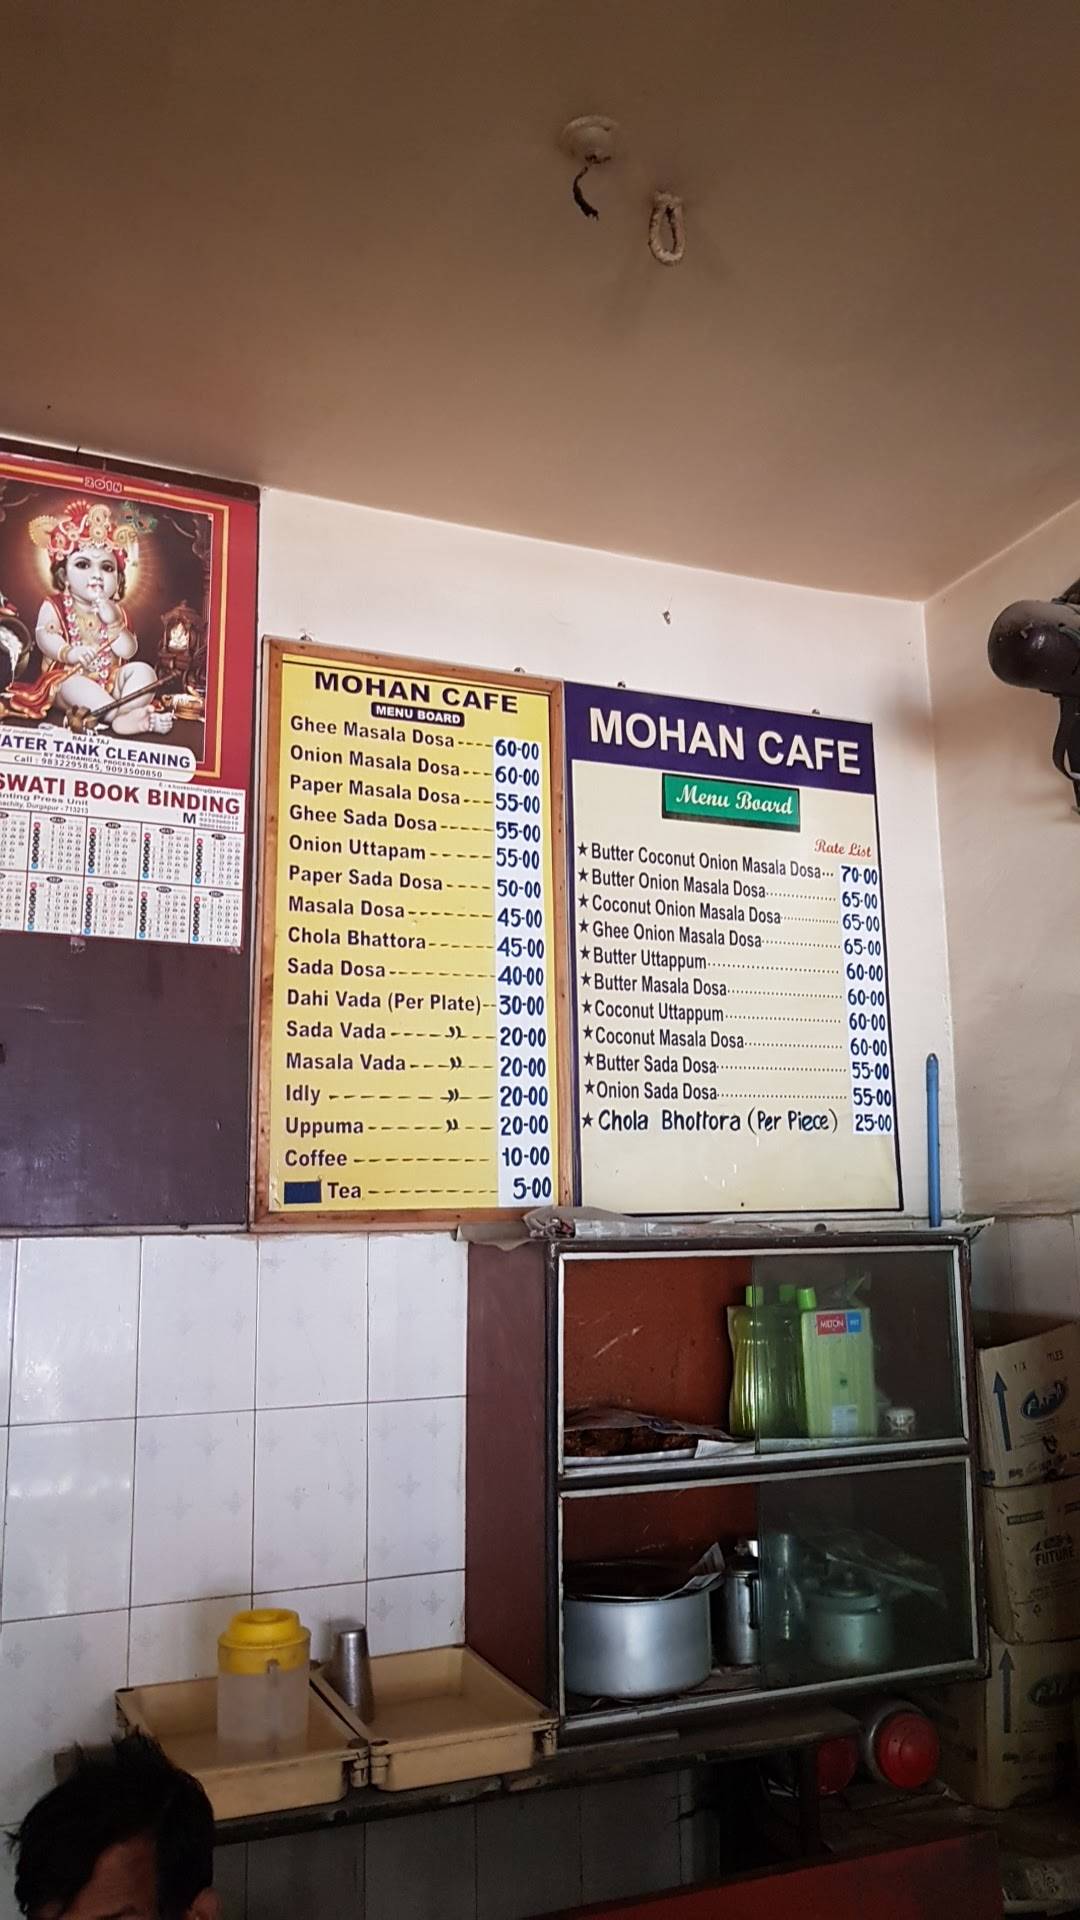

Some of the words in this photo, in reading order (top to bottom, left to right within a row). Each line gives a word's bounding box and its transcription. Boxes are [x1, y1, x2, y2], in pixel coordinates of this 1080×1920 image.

[315, 671, 430, 703] MOHAN
[442, 687, 518, 714] CAFE
[376, 705, 414, 719] MENU
[417, 710, 461, 725] BOARD
[0, 735, 47, 750] ATER
[53, 740, 100, 757] TANK
[106, 747, 190, 768] CLEANING
[291, 715, 337, 734] Ghee
[344, 721, 406, 742] Masala
[412, 729, 455, 748] Dosa
[495, 739, 539, 760] 60-00
[589, 706, 745, 760] MOHAN
[758, 730, 861, 776] CAFE
[14, 755, 33, 763] Call
[291, 745, 343, 764] Onion
[349, 750, 411, 772] Masala
[418, 758, 460, 776] Dosa
[495, 766, 539, 786] 60-00
[0, 773, 65, 795] SWATI
[74, 780, 139, 803] BOOK
[148, 789, 240, 814] BINDING
[33, 795, 63, 803] Press
[290, 775, 343, 795] Paper
[349, 780, 411, 800] Masala
[418, 787, 460, 805] Dosa
[496, 793, 540, 813] 55-00
[675, 784, 730, 808] Menu
[736, 791, 793, 815] Board
[183, 812, 196, 824] M
[290, 805, 337, 823] Ghee
[343, 809, 387, 827] Sada
[394, 813, 437, 831] Dosa
[496, 822, 540, 842] 55-00
[289, 835, 342, 854] Onion
[349, 840, 426, 861] Uttapam
[496, 848, 539, 869] 55-00
[591, 842, 634, 862] Butter
[638, 847, 695, 868] Coconut
[699, 853, 738, 872] Onion
[742, 856, 786, 876] Masala
[790, 862, 821, 879] Dosa
[841, 865, 878, 886] 70-00
[814, 839, 846, 856] Rate
[849, 842, 872, 858] List
[289, 865, 342, 886] Paper
[349, 869, 393, 887] Sada
[400, 873, 443, 891] Dosa
[496, 880, 541, 898] 50-00
[592, 869, 635, 888] Butter
[639, 873, 680, 892] Onion
[684, 877, 730, 895] Masala
[733, 881, 766, 898] Dosa
[842, 892, 878, 910] 65-00
[288, 896, 353, 915] Masala
[361, 901, 405, 918] Dosa
[497, 908, 542, 928] 45-00
[592, 894, 651, 915] Coconut
[655, 899, 696, 918] Onion
[699, 903, 745, 922] Masala
[749, 908, 781, 924] Dosa
[843, 914, 880, 932] 65-00
[288, 927, 340, 945] Chola
[348, 930, 426, 950] Bhattora
[497, 937, 544, 959] 45-00
[592, 921, 629, 940] Ghee
[634, 923, 675, 942] Onion
[679, 926, 725, 945] Masala
[729, 930, 762, 948] Dosa
[844, 939, 881, 956] 65-00
[288, 958, 334, 975] Sada
[340, 960, 385, 977] Dosa
[498, 966, 543, 986] 40-00
[593, 947, 637, 965] Butter
[641, 950, 707, 972] Uttappum
[846, 963, 883, 982] 60-00
[287, 989, 329, 1006] Dahi
[336, 991, 381, 1008] Vada
[387, 992, 424, 1013] (Per
[431, 995, 481, 1015] Plate)
[499, 995, 544, 1015] 30-00
[594, 973, 638, 992] Butter
[641, 975, 689, 994] Masala
[693, 979, 727, 996] Dosa
[848, 989, 885, 1007] 60-00
[594, 1000, 654, 1020] Coconut
[658, 1002, 724, 1025] Uttappum
[849, 1013, 886, 1031] 60-00
[286, 1021, 333, 1038] Sada
[340, 1022, 385, 1039] Vada
[500, 1027, 546, 1047] 20-00
[595, 1026, 656, 1046] Coconut
[659, 1029, 707, 1047] Masala
[710, 1031, 744, 1049] Dosa
[850, 1038, 887, 1057] 60-00
[286, 1052, 353, 1070] Masala
[360, 1054, 406, 1071] Vada
[500, 1056, 546, 1077] 20-00
[596, 1053, 640, 1072] Butter
[644, 1055, 679, 1073] Sada
[682, 1057, 718, 1074] Dosa
[851, 1061, 889, 1080] 55-00
[285, 1085, 321, 1106] Idly
[500, 1086, 548, 1106] 20-00
[597, 1080, 640, 1099] Onion
[644, 1082, 679, 1100] Sada
[682, 1083, 718, 1100] Dosa
[853, 1088, 891, 1107] 55-00
[285, 1117, 364, 1137] Uppuma
[500, 1115, 548, 1136] 20-00
[600, 1109, 649, 1132] Chola
[748, 1107, 782, 1135] (Per
[855, 1113, 892, 1132] 25-00
[285, 1150, 347, 1167] Coffee
[502, 1147, 550, 1167] 10-00
[327, 1183, 361, 1199] Tea
[513, 1177, 551, 1199] 5-00
